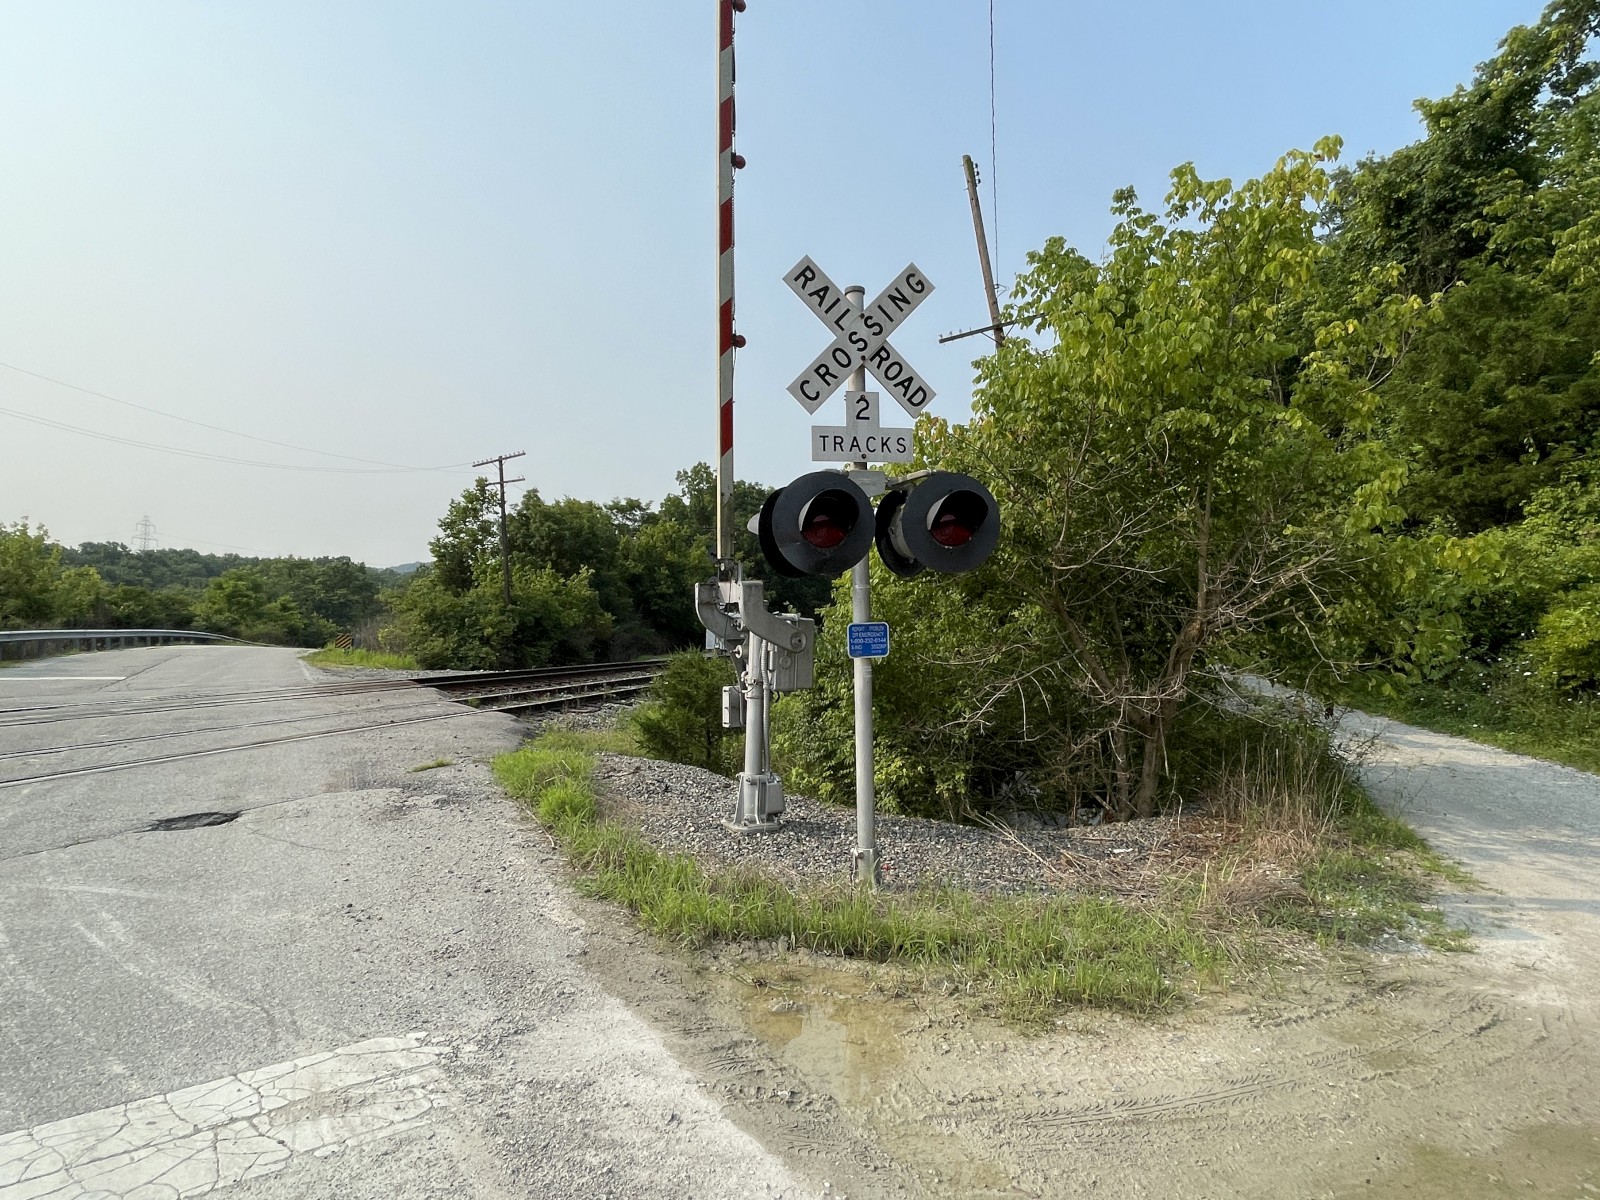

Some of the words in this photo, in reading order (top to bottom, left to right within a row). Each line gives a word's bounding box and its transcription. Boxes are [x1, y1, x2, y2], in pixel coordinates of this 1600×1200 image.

[793, 265, 851, 331] RAIL
[869, 345, 927, 407] ROAD
[799, 273, 925, 401] CROSSING
[819, 435, 906, 453] TRACKS
[855, 398, 870, 420] 2
